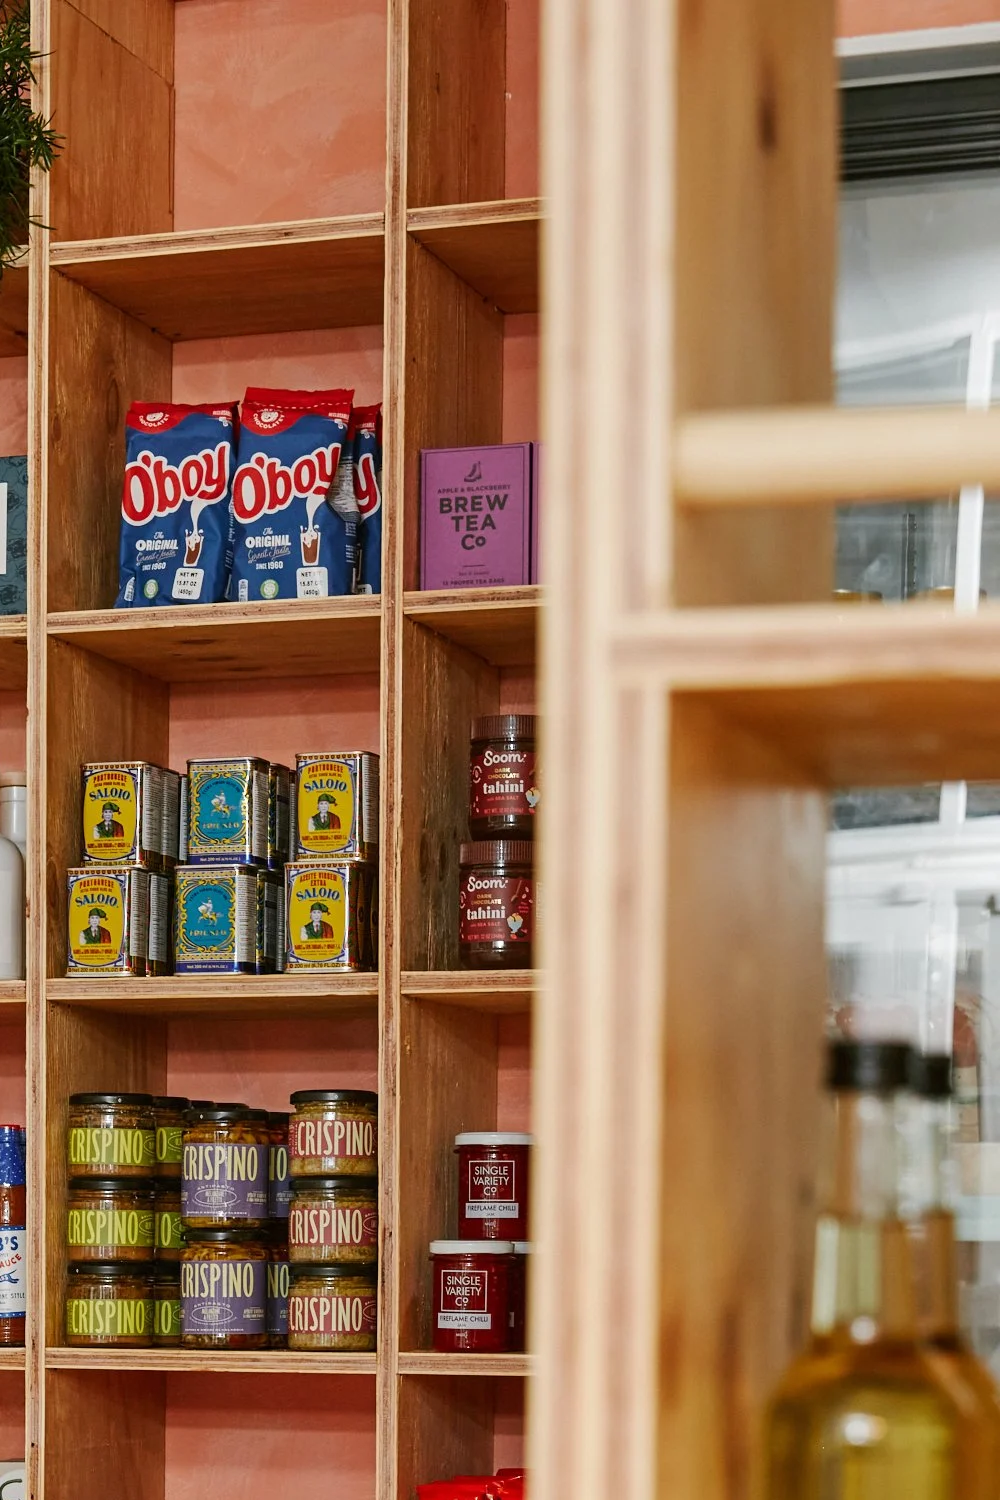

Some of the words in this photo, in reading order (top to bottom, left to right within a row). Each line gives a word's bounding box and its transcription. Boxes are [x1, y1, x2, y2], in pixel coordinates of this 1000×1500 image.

[440, 494, 508, 514] BREW
[451, 514, 496, 532] TEA
[136, 540, 178, 552] ORIGINAL
[245, 535, 291, 547] ORIGINAL
[268, 561, 283, 569] 1960
[304, 780, 348, 792] SALOIO
[483, 780, 524, 794] tahini
[89, 789, 132, 801] SALOIO
[296, 888, 341, 901] SALOIO
[75, 896, 118, 908] SALOIO
[467, 907, 506, 920] tahini
[298, 1121, 372, 1156] CRISPINO
[70, 1129, 143, 1163] CRISPINO
[183, 1146, 258, 1181] CRISPINO
[475, 1166, 508, 1175] SINGLE
[473, 1177, 509, 1186] VARIETY
[290, 1210, 363, 1244] CRISPINO
[181, 1263, 254, 1298] CRISPINO
[447, 1276, 480, 1286] SINGLE
[445, 1286, 482, 1296] VARIETY
[72, 1301, 145, 1333] CRISPINO
